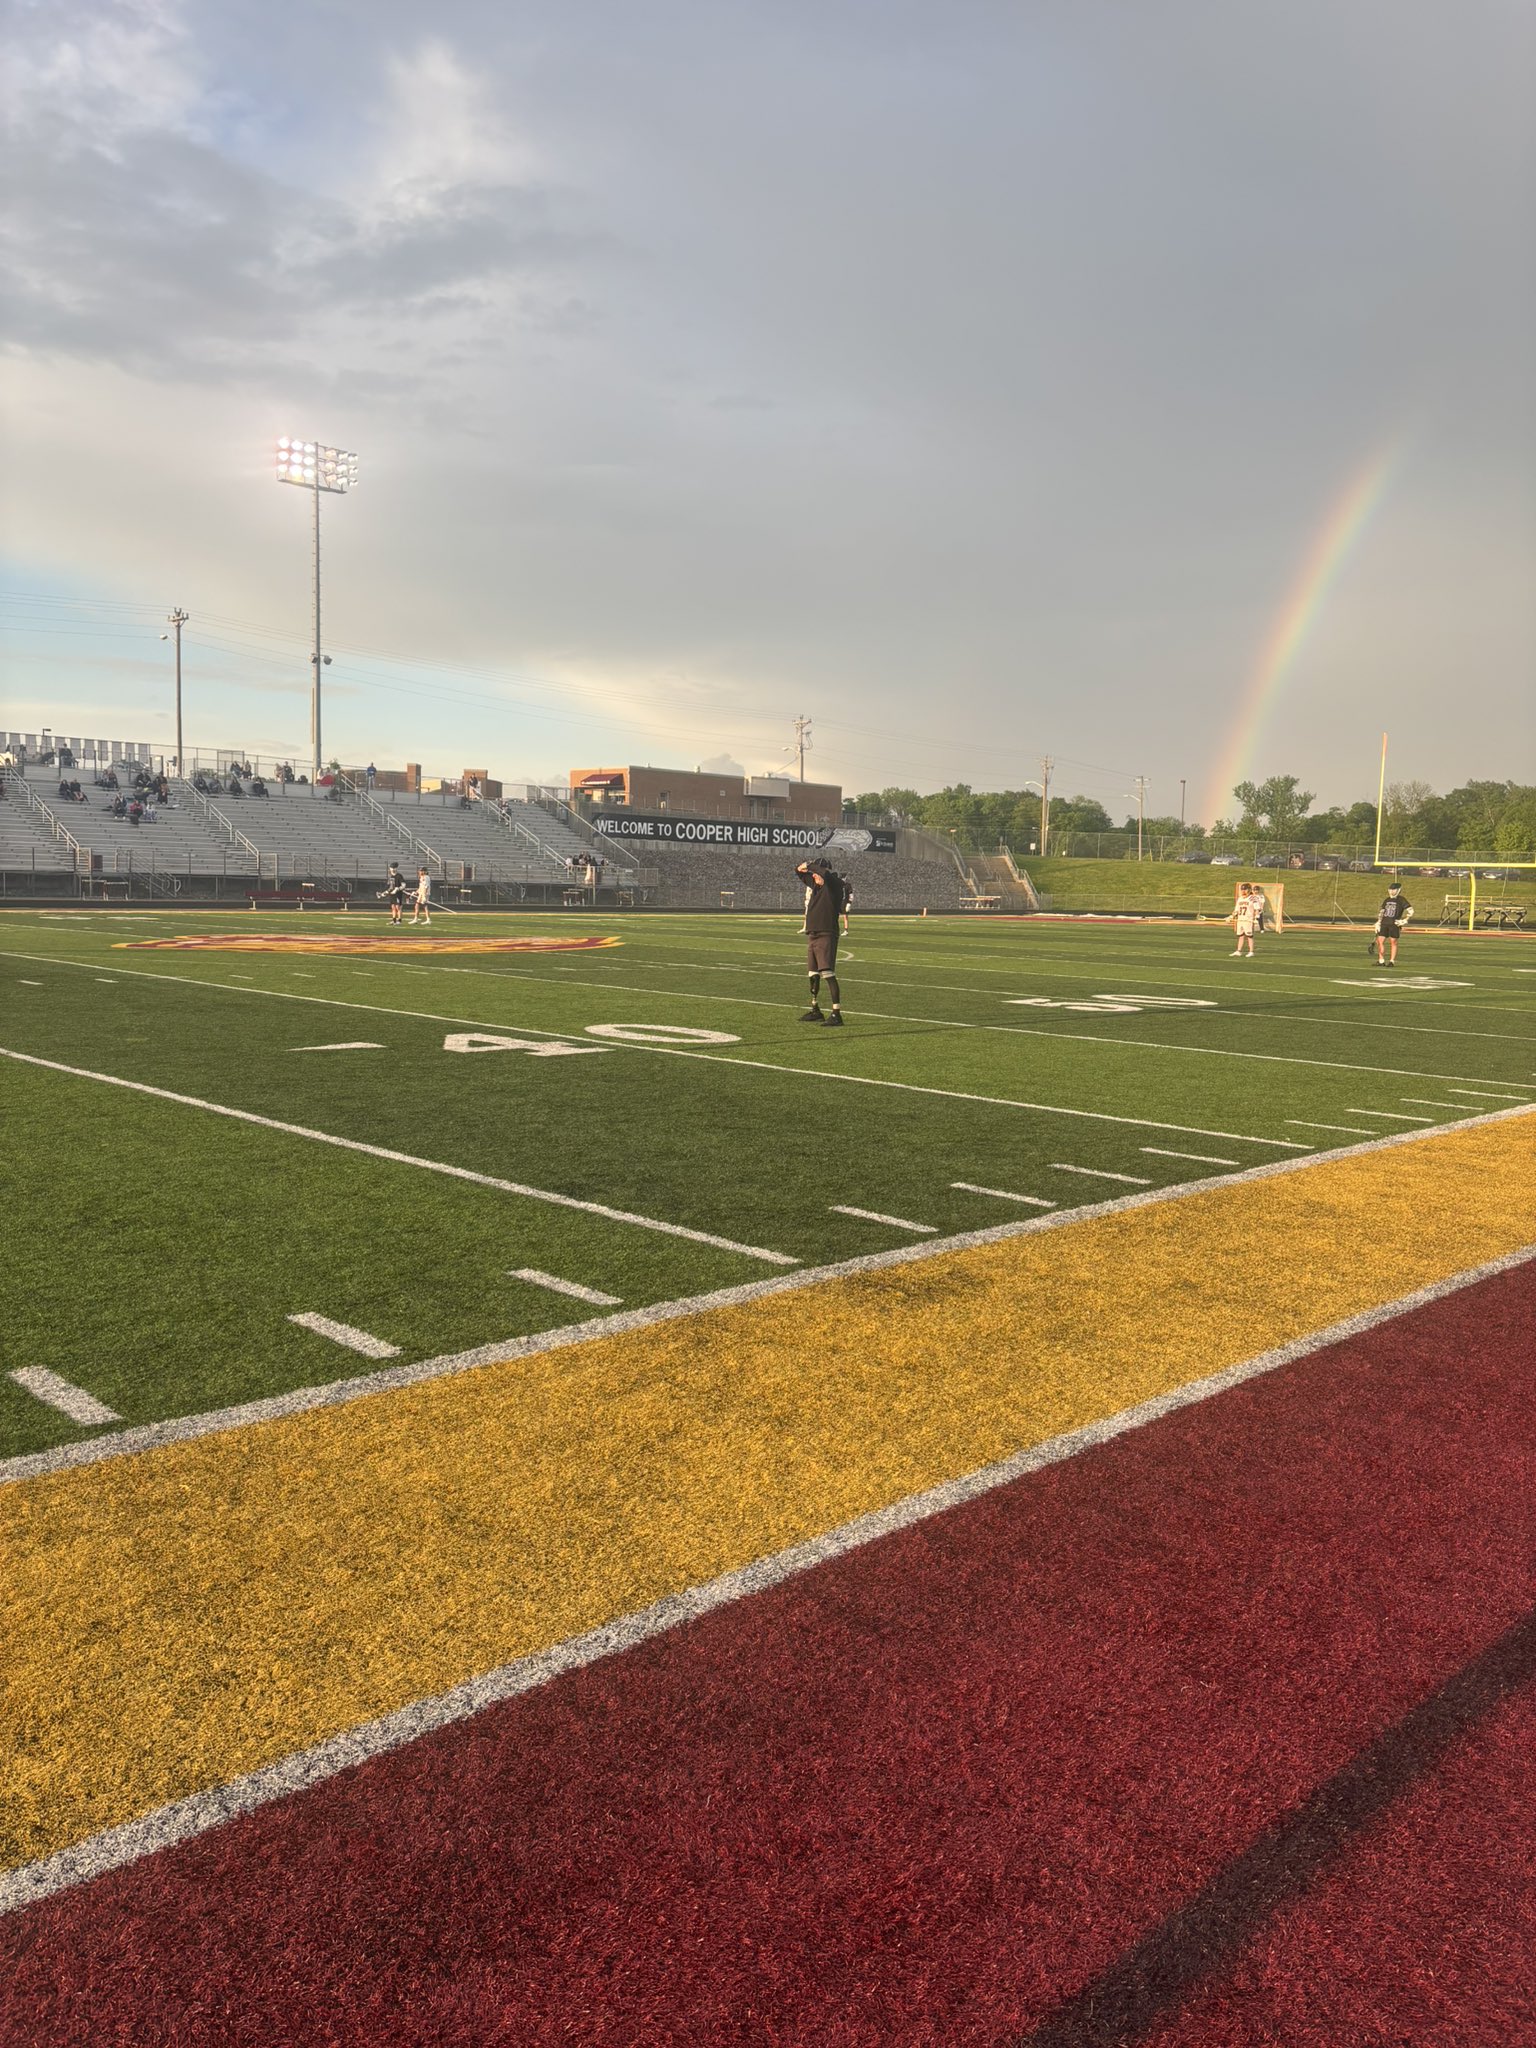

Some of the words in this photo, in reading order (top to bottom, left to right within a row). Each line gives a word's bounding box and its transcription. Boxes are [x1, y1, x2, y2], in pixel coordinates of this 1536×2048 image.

[596, 820, 654, 836] WELCOME
[657, 823, 672, 836] TO
[675, 822, 733, 842] COOPER
[737, 826, 769, 843] HIGH
[772, 828, 823, 846] SCHOOL
[1000, 994, 1219, 1012] 50
[443, 1023, 742, 1056] 40
